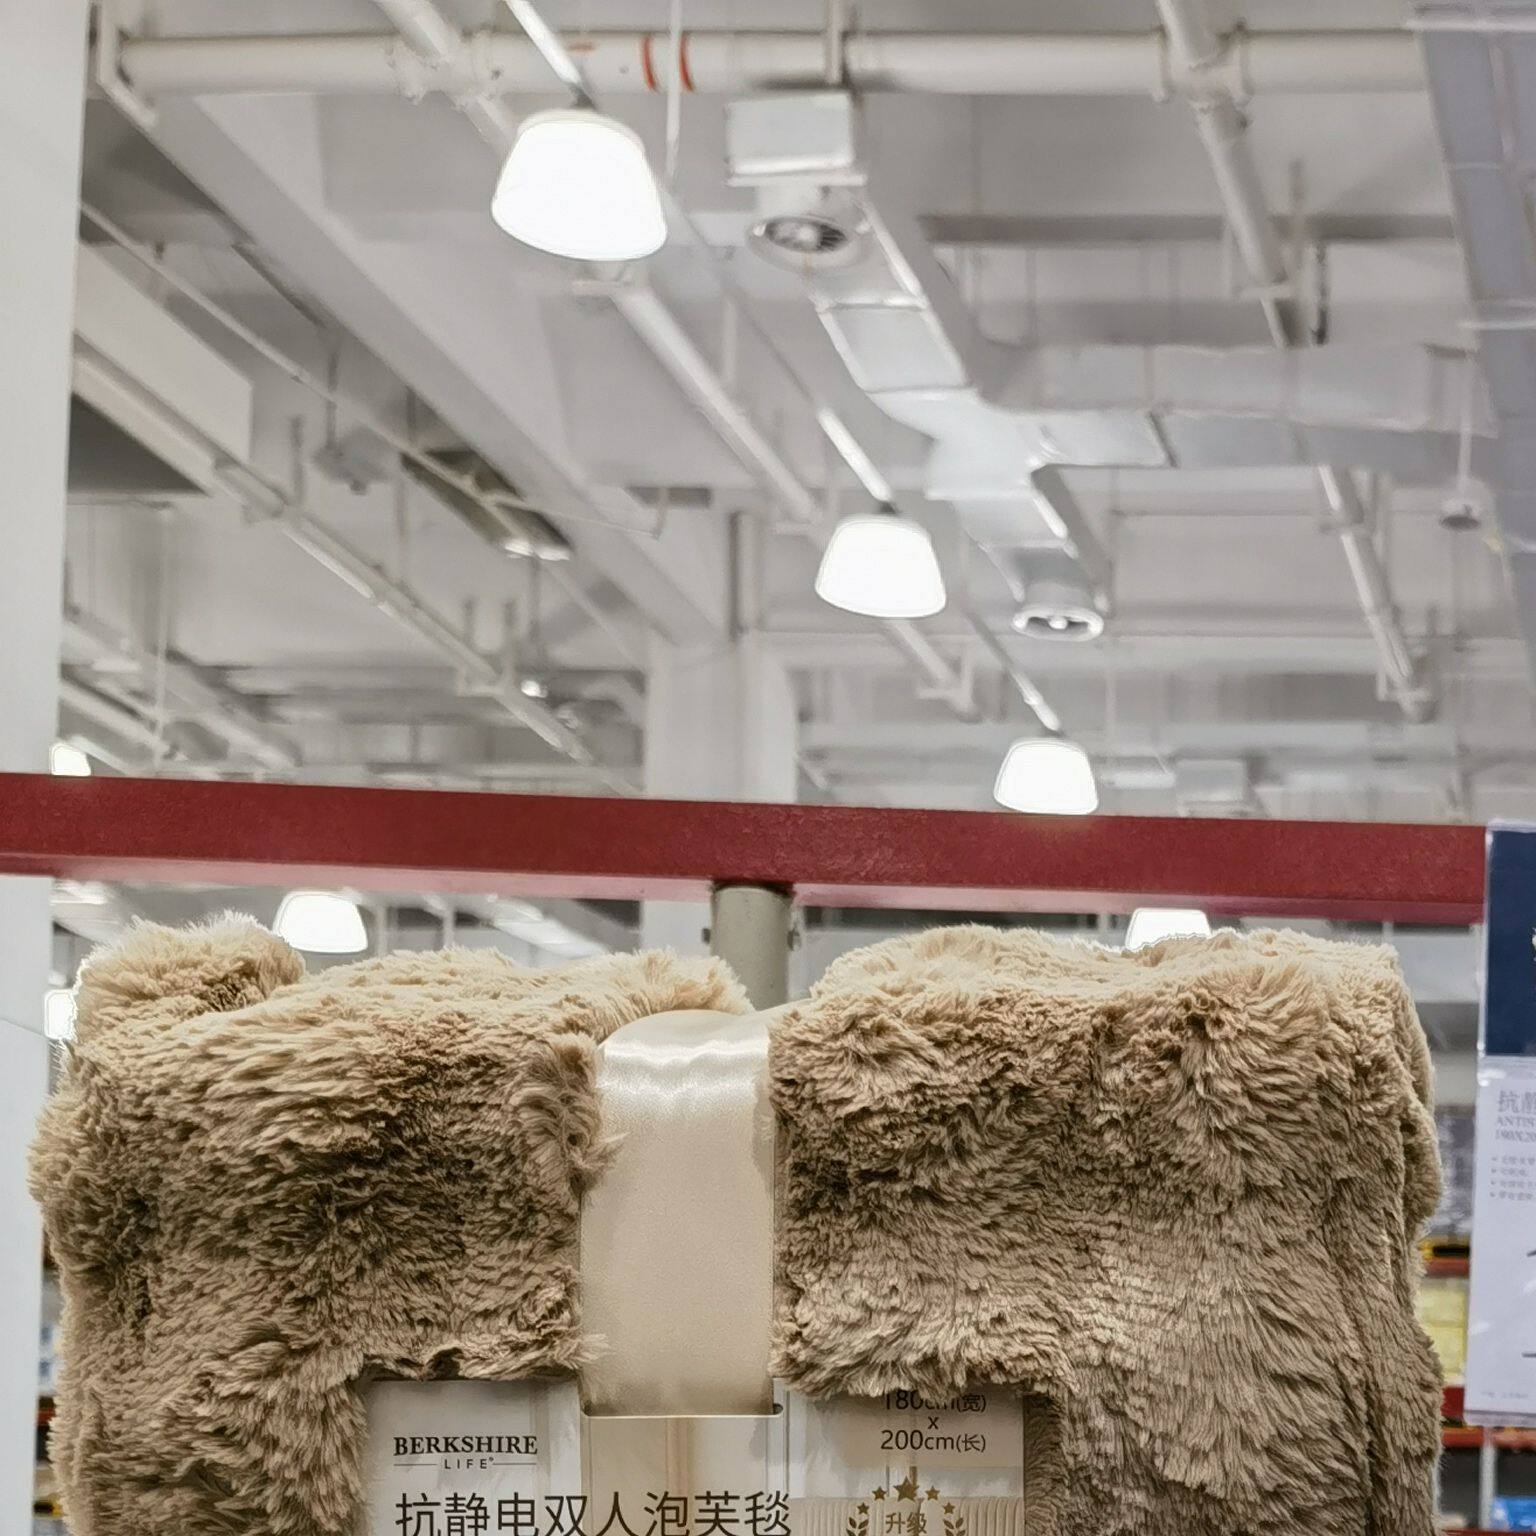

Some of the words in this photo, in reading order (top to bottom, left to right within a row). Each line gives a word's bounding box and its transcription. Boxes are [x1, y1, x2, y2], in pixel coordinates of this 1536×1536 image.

[393, 1436, 538, 1456] BERKSHIRE
[880, 1429, 986, 1453] 200cm(长)
[885, 1511, 927, 1535] 升级
